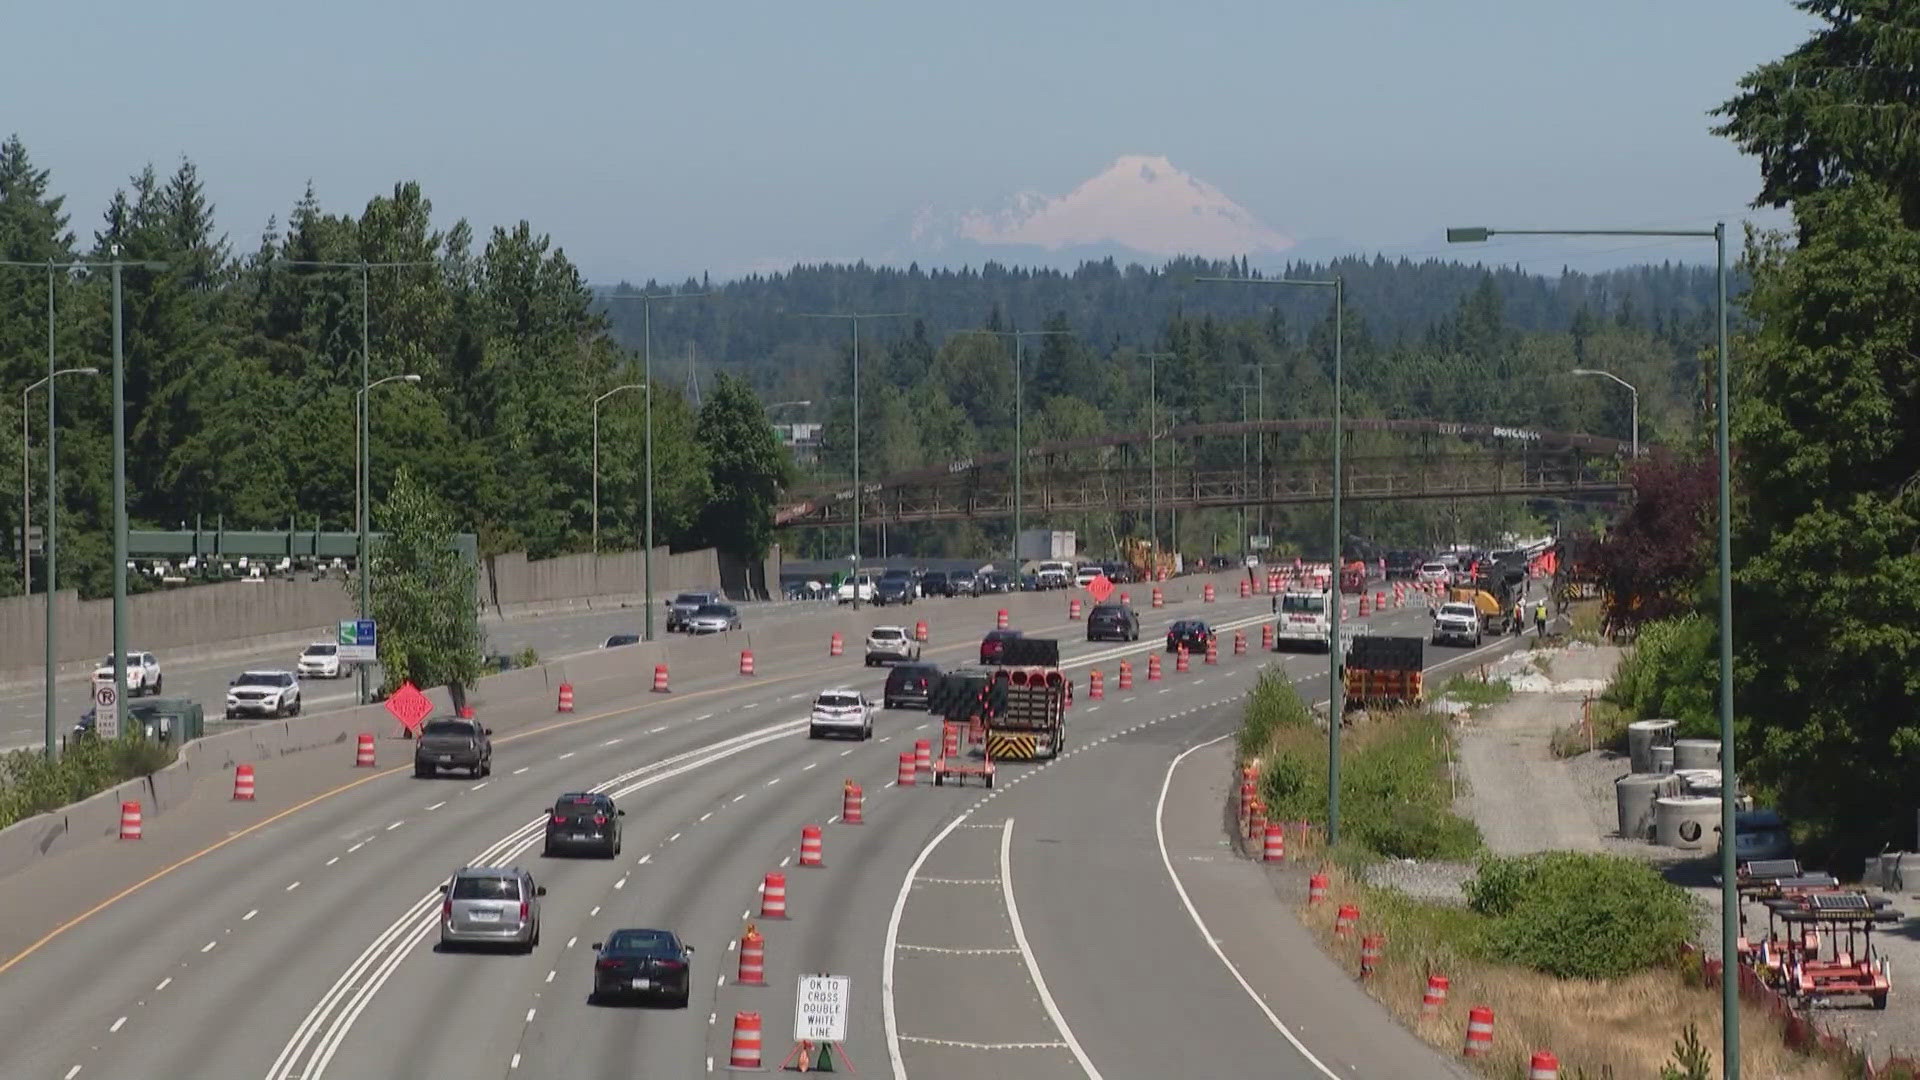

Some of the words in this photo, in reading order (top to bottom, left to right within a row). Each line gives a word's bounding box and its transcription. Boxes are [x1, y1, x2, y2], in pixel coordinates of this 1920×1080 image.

[810, 980, 822, 991] OK
[828, 981, 839, 990] TO
[808, 991, 838, 1002] CROSS
[803, 1003, 840, 1015] DOUBLE
[808, 1015, 835, 1026] WHITE
[810, 1027, 831, 1038] LINE
